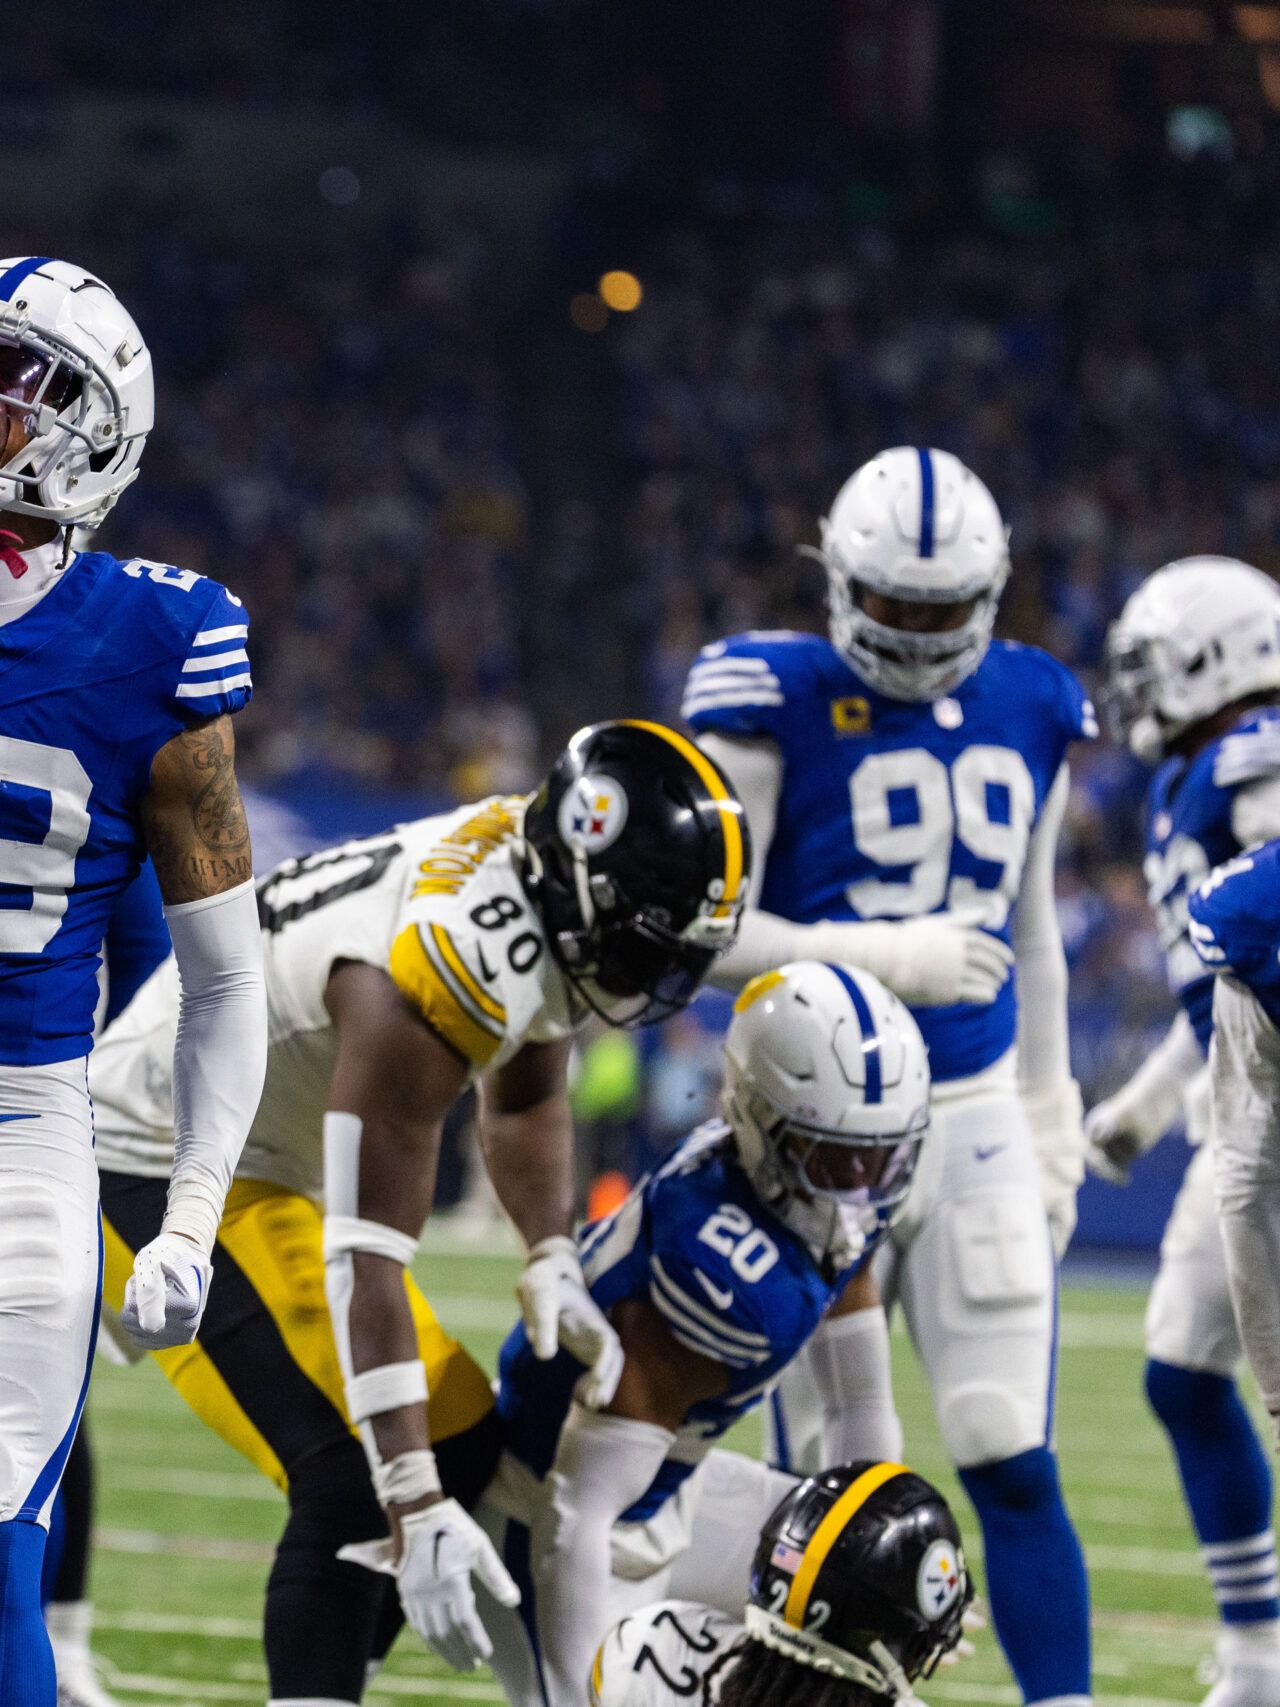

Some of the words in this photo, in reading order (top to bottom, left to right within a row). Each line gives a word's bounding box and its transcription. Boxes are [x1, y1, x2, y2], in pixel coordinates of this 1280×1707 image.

[846, 743, 1036, 920] 99
[469, 896, 542, 974] 80
[696, 1203, 780, 1284] 20
[770, 1578, 832, 1635] 22
[632, 1610, 718, 1697] 22
